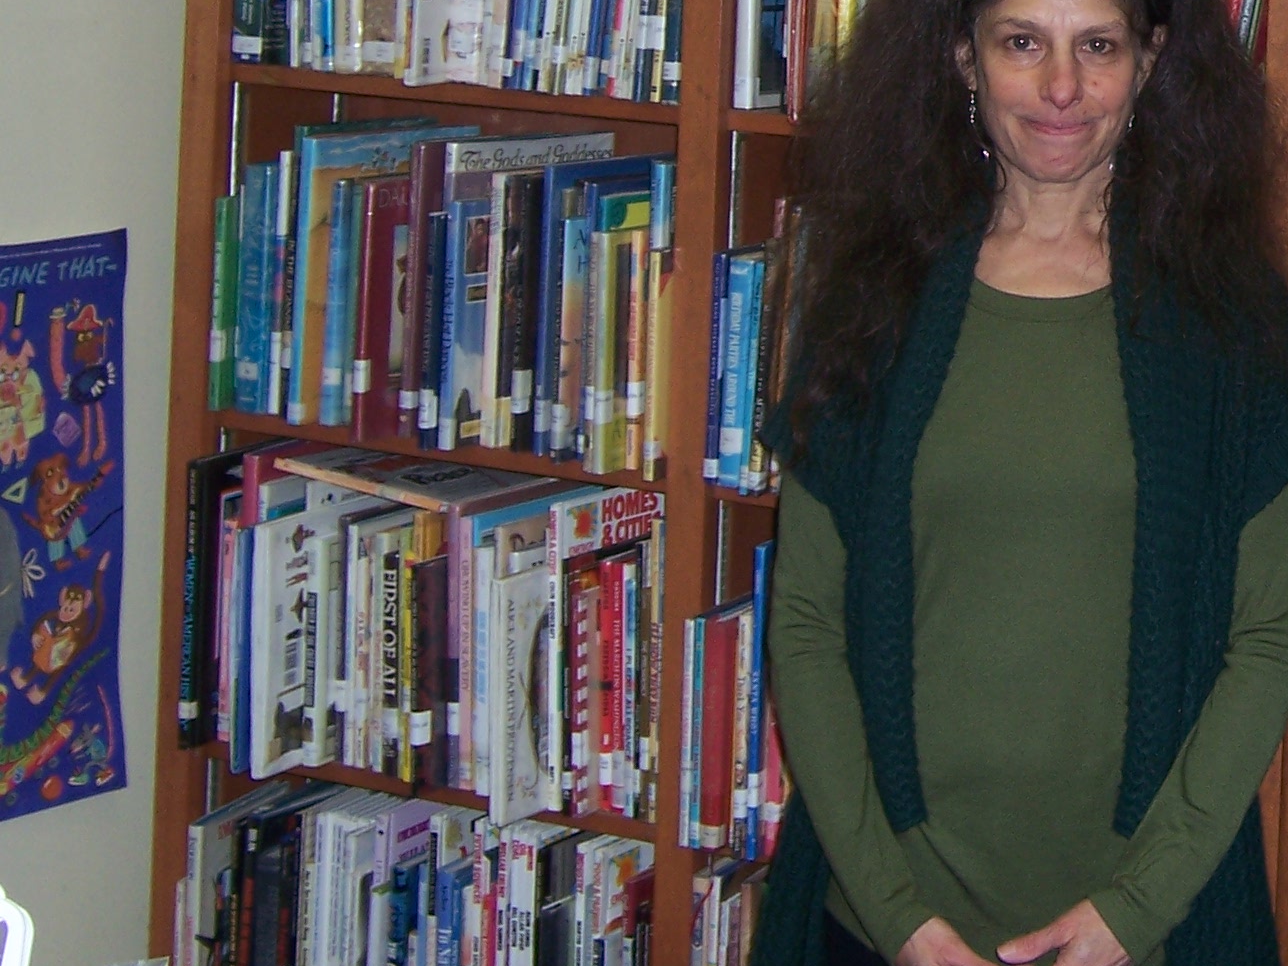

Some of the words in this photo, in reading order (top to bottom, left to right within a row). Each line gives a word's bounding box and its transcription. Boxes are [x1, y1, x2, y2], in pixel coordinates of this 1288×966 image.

[725, 372, 737, 407] AROUND
[383, 569, 398, 624] FIRST
[506, 599, 516, 632] ALICE
[383, 629, 397, 654] OF
[507, 637, 515, 665] AND
[506, 668, 516, 716] MARTIN
[506, 720, 516, 802] PROVENSEN
